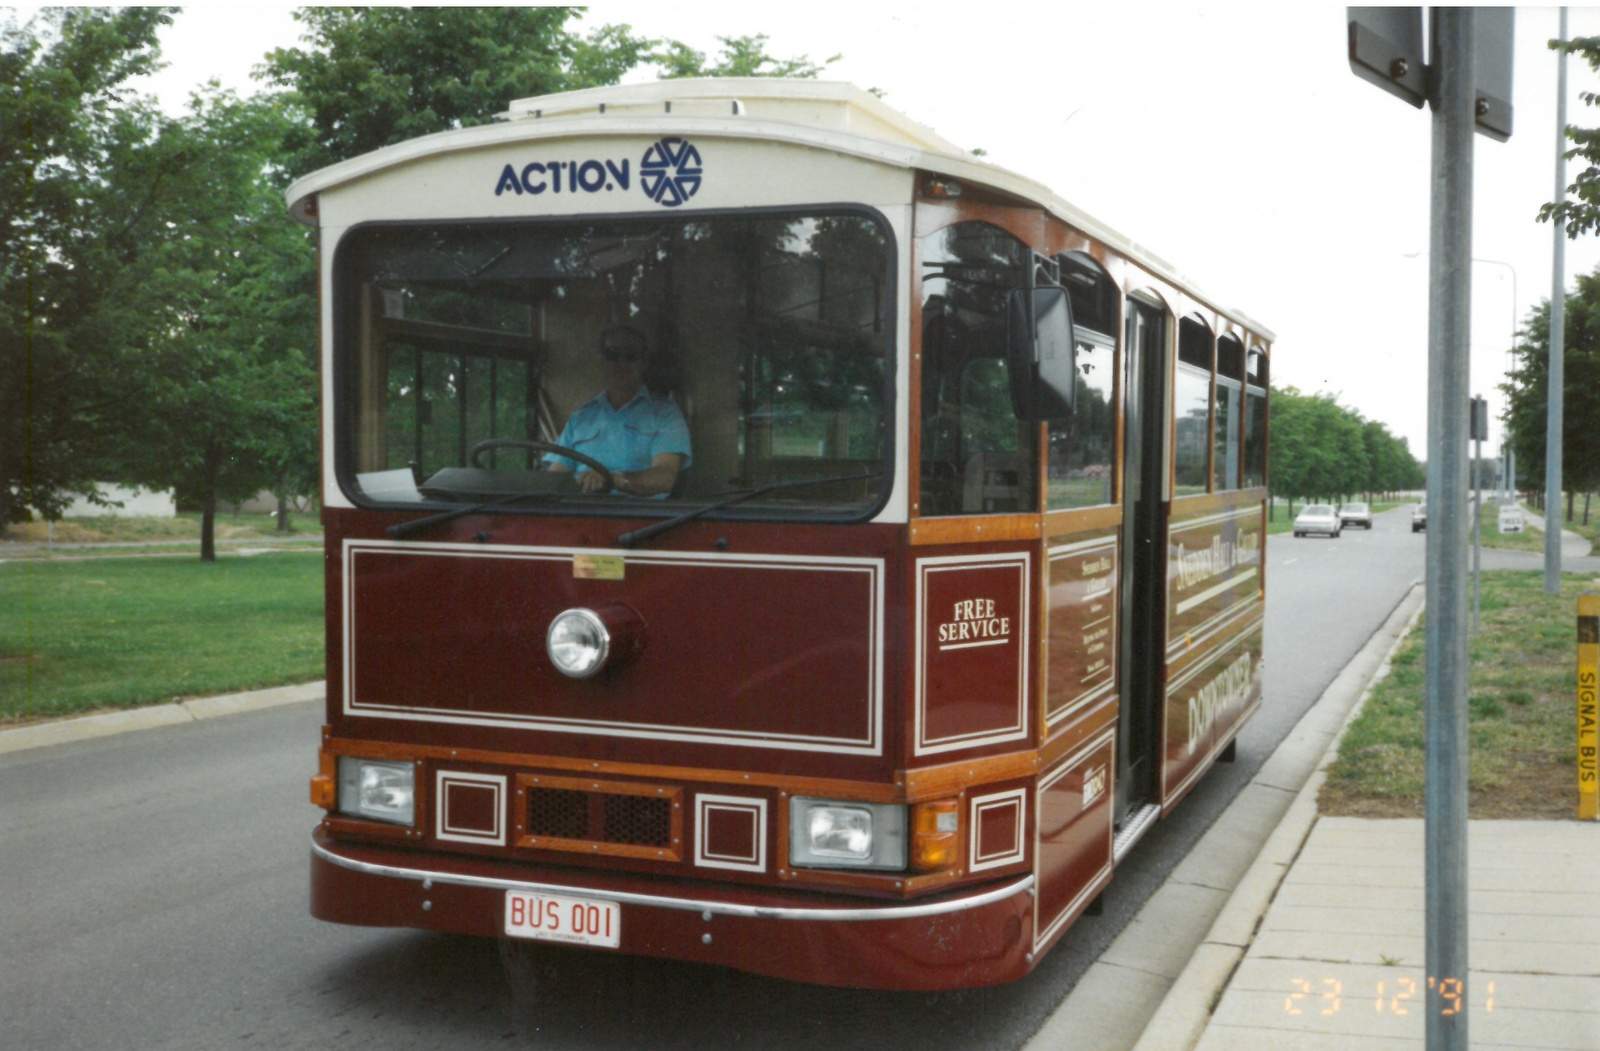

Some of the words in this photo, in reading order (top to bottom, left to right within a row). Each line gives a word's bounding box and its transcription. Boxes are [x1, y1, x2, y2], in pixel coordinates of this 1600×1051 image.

[495, 158, 630, 196] ACTION
[954, 598, 996, 621] FREE
[938, 617, 1010, 642] SERVICE
[1580, 672, 1596, 738] SIGNAL
[1580, 746, 1596, 782] BUS
[511, 896, 560, 930] BUS
[572, 903, 611, 938] 001
